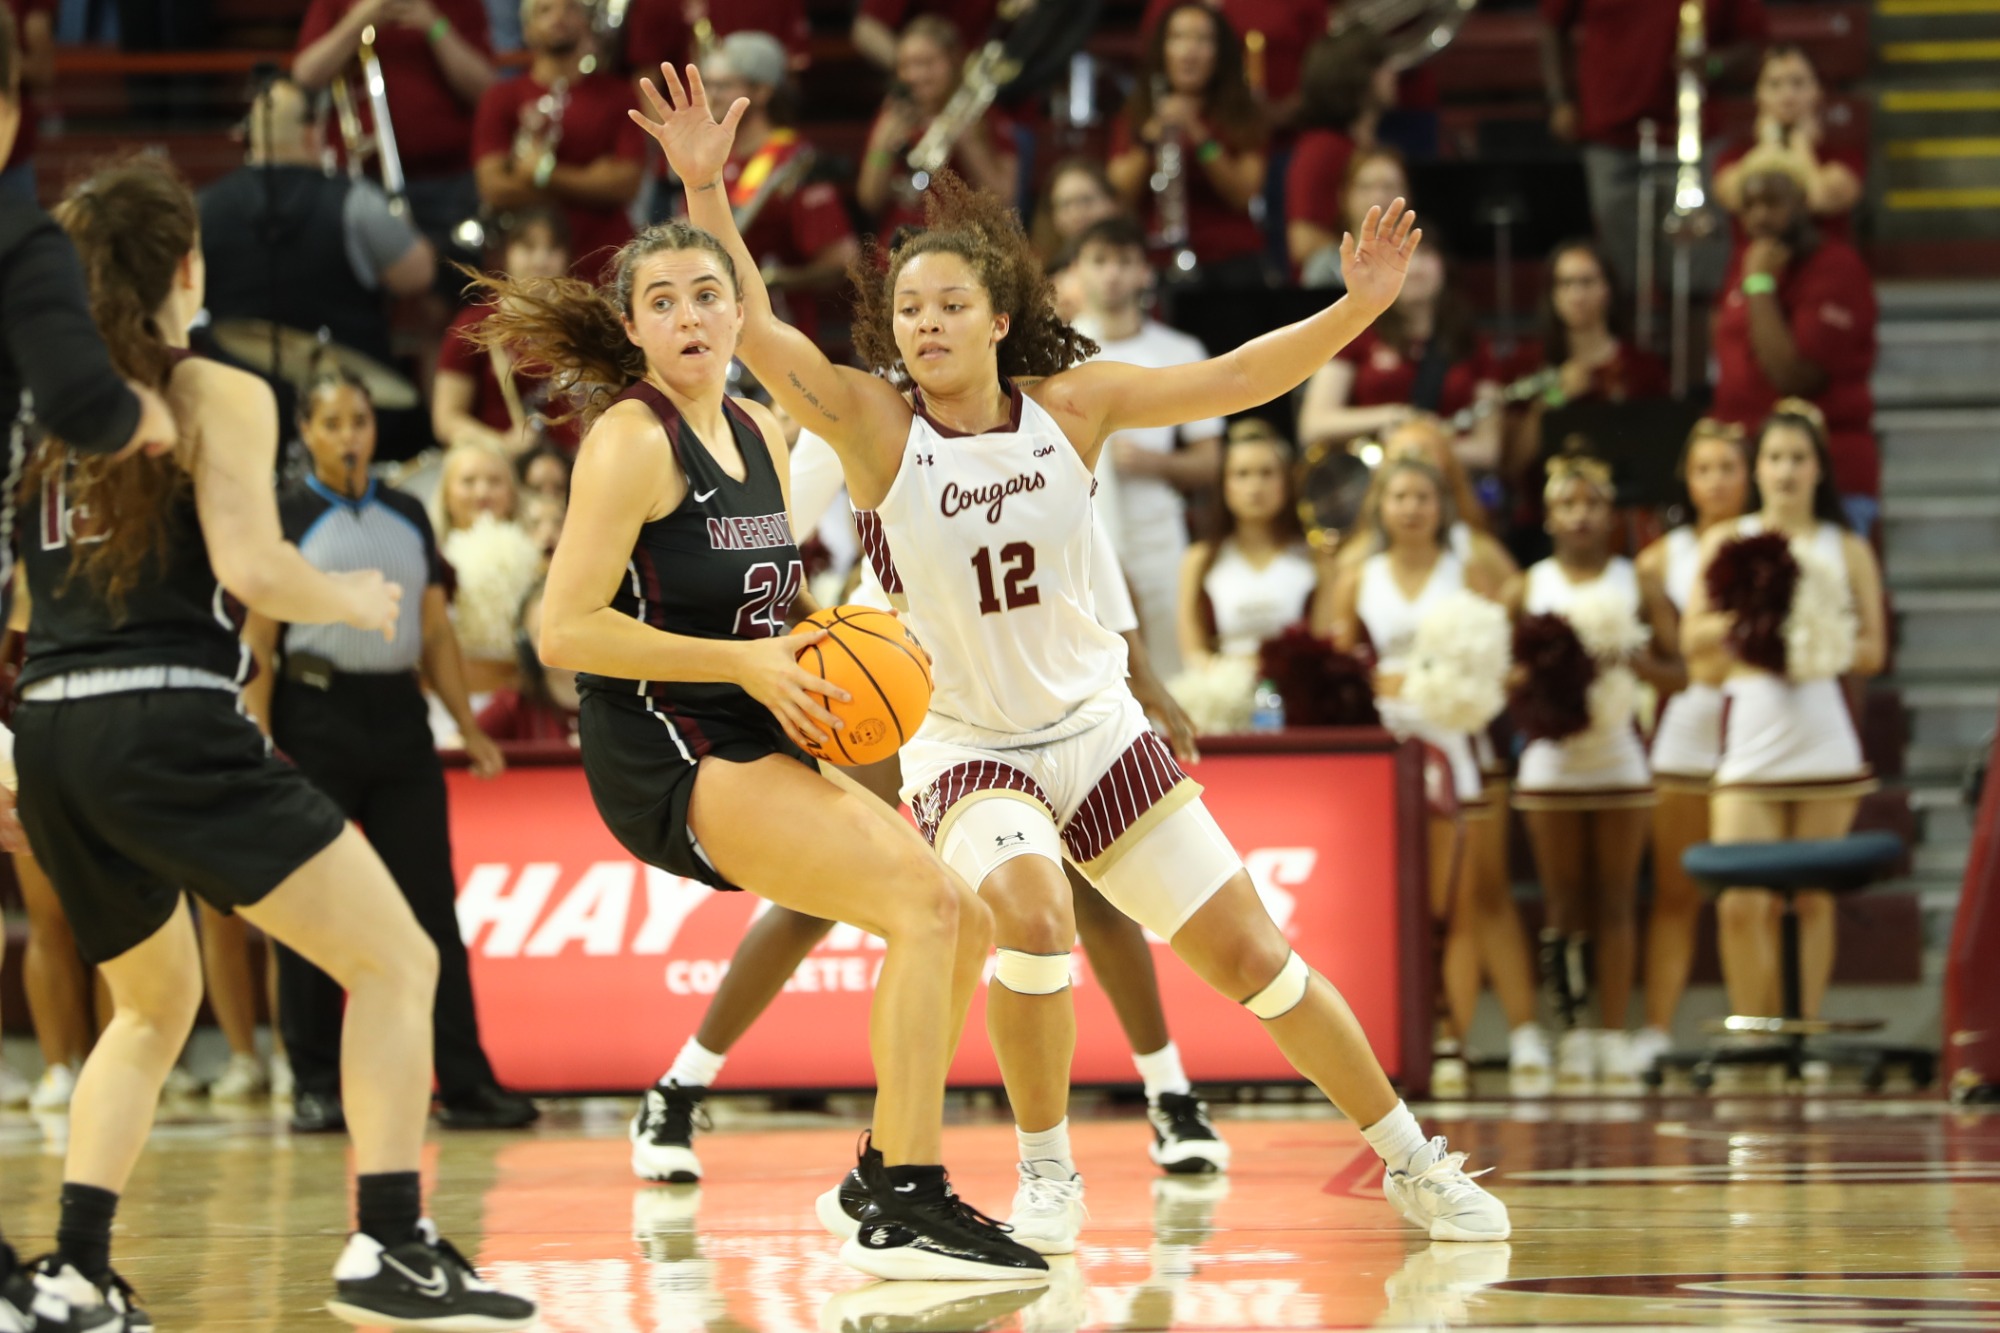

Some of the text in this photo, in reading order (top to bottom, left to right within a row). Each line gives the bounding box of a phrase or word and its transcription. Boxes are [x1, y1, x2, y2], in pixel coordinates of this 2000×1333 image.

[1033, 444, 1056, 458] CAA
[940, 471, 1046, 525] Cougars
[732, 560, 803, 639] 24
[970, 540, 1041, 617] 12
[455, 861, 722, 957] HAY
